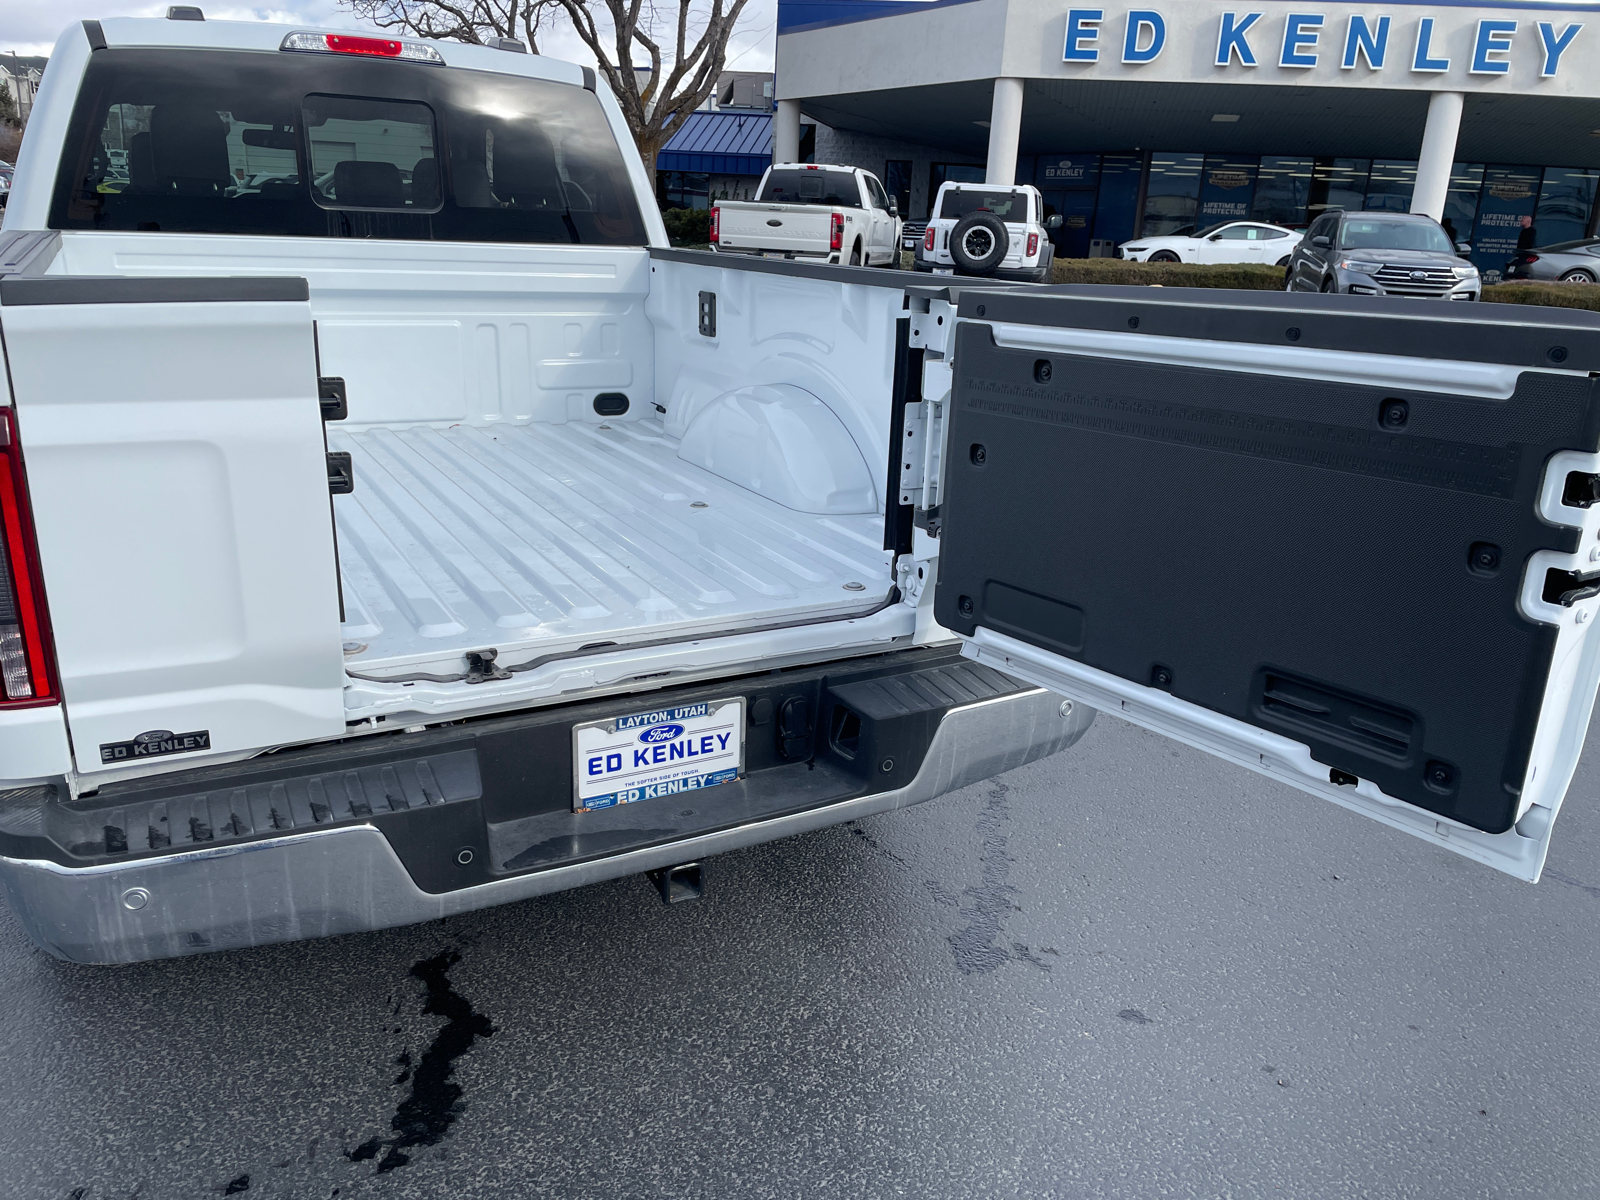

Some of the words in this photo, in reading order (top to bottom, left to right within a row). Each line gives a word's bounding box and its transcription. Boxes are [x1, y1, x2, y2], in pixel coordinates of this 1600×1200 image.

[1062, 7, 1167, 64] ED
[1213, 10, 1586, 78] KENLEY
[1045, 168, 1055, 177] ED
[1056, 168, 1084, 177] KENLEY
[1481, 219, 1522, 228] PROTECTIO
[1482, 213, 1516, 221] LIFETIME
[618, 711, 671, 729] LAYTON,
[674, 703, 707, 720] UTAH
[647, 727, 676, 743] Ford
[101, 747, 127, 761] ED
[134, 735, 208, 755] KENLEY
[588, 752, 622, 776] ED
[633, 731, 732, 768] KENLEY
[617, 789, 640, 805] ED
[645, 775, 708, 799] KENLEY
[637, 777, 658, 785] SOFTER
